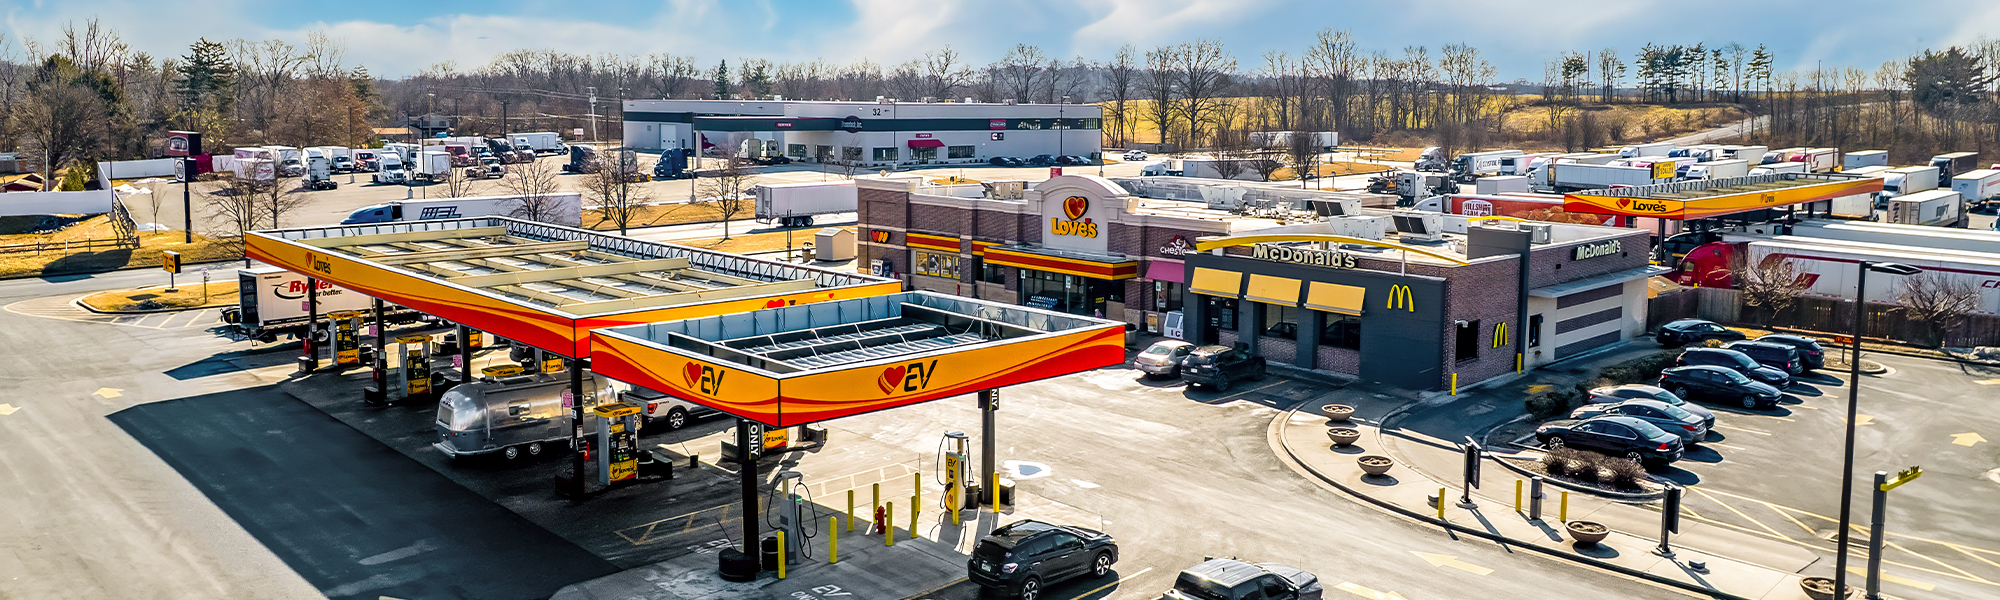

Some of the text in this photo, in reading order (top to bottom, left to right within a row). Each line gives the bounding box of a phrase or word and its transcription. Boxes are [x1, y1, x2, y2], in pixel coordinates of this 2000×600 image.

[872, 108, 881, 116] 32
[1633, 200, 1667, 212] Love's
[1051, 217, 1099, 239] Love's
[1252, 243, 1356, 269] McDonald's
[1576, 239, 1621, 261] McDonald's
[313, 254, 332, 275] Love's
[701, 365, 726, 397] EV
[904, 359, 939, 392] EV
[750, 424, 759, 456] ONLY
[811, 584, 853, 597] EV
